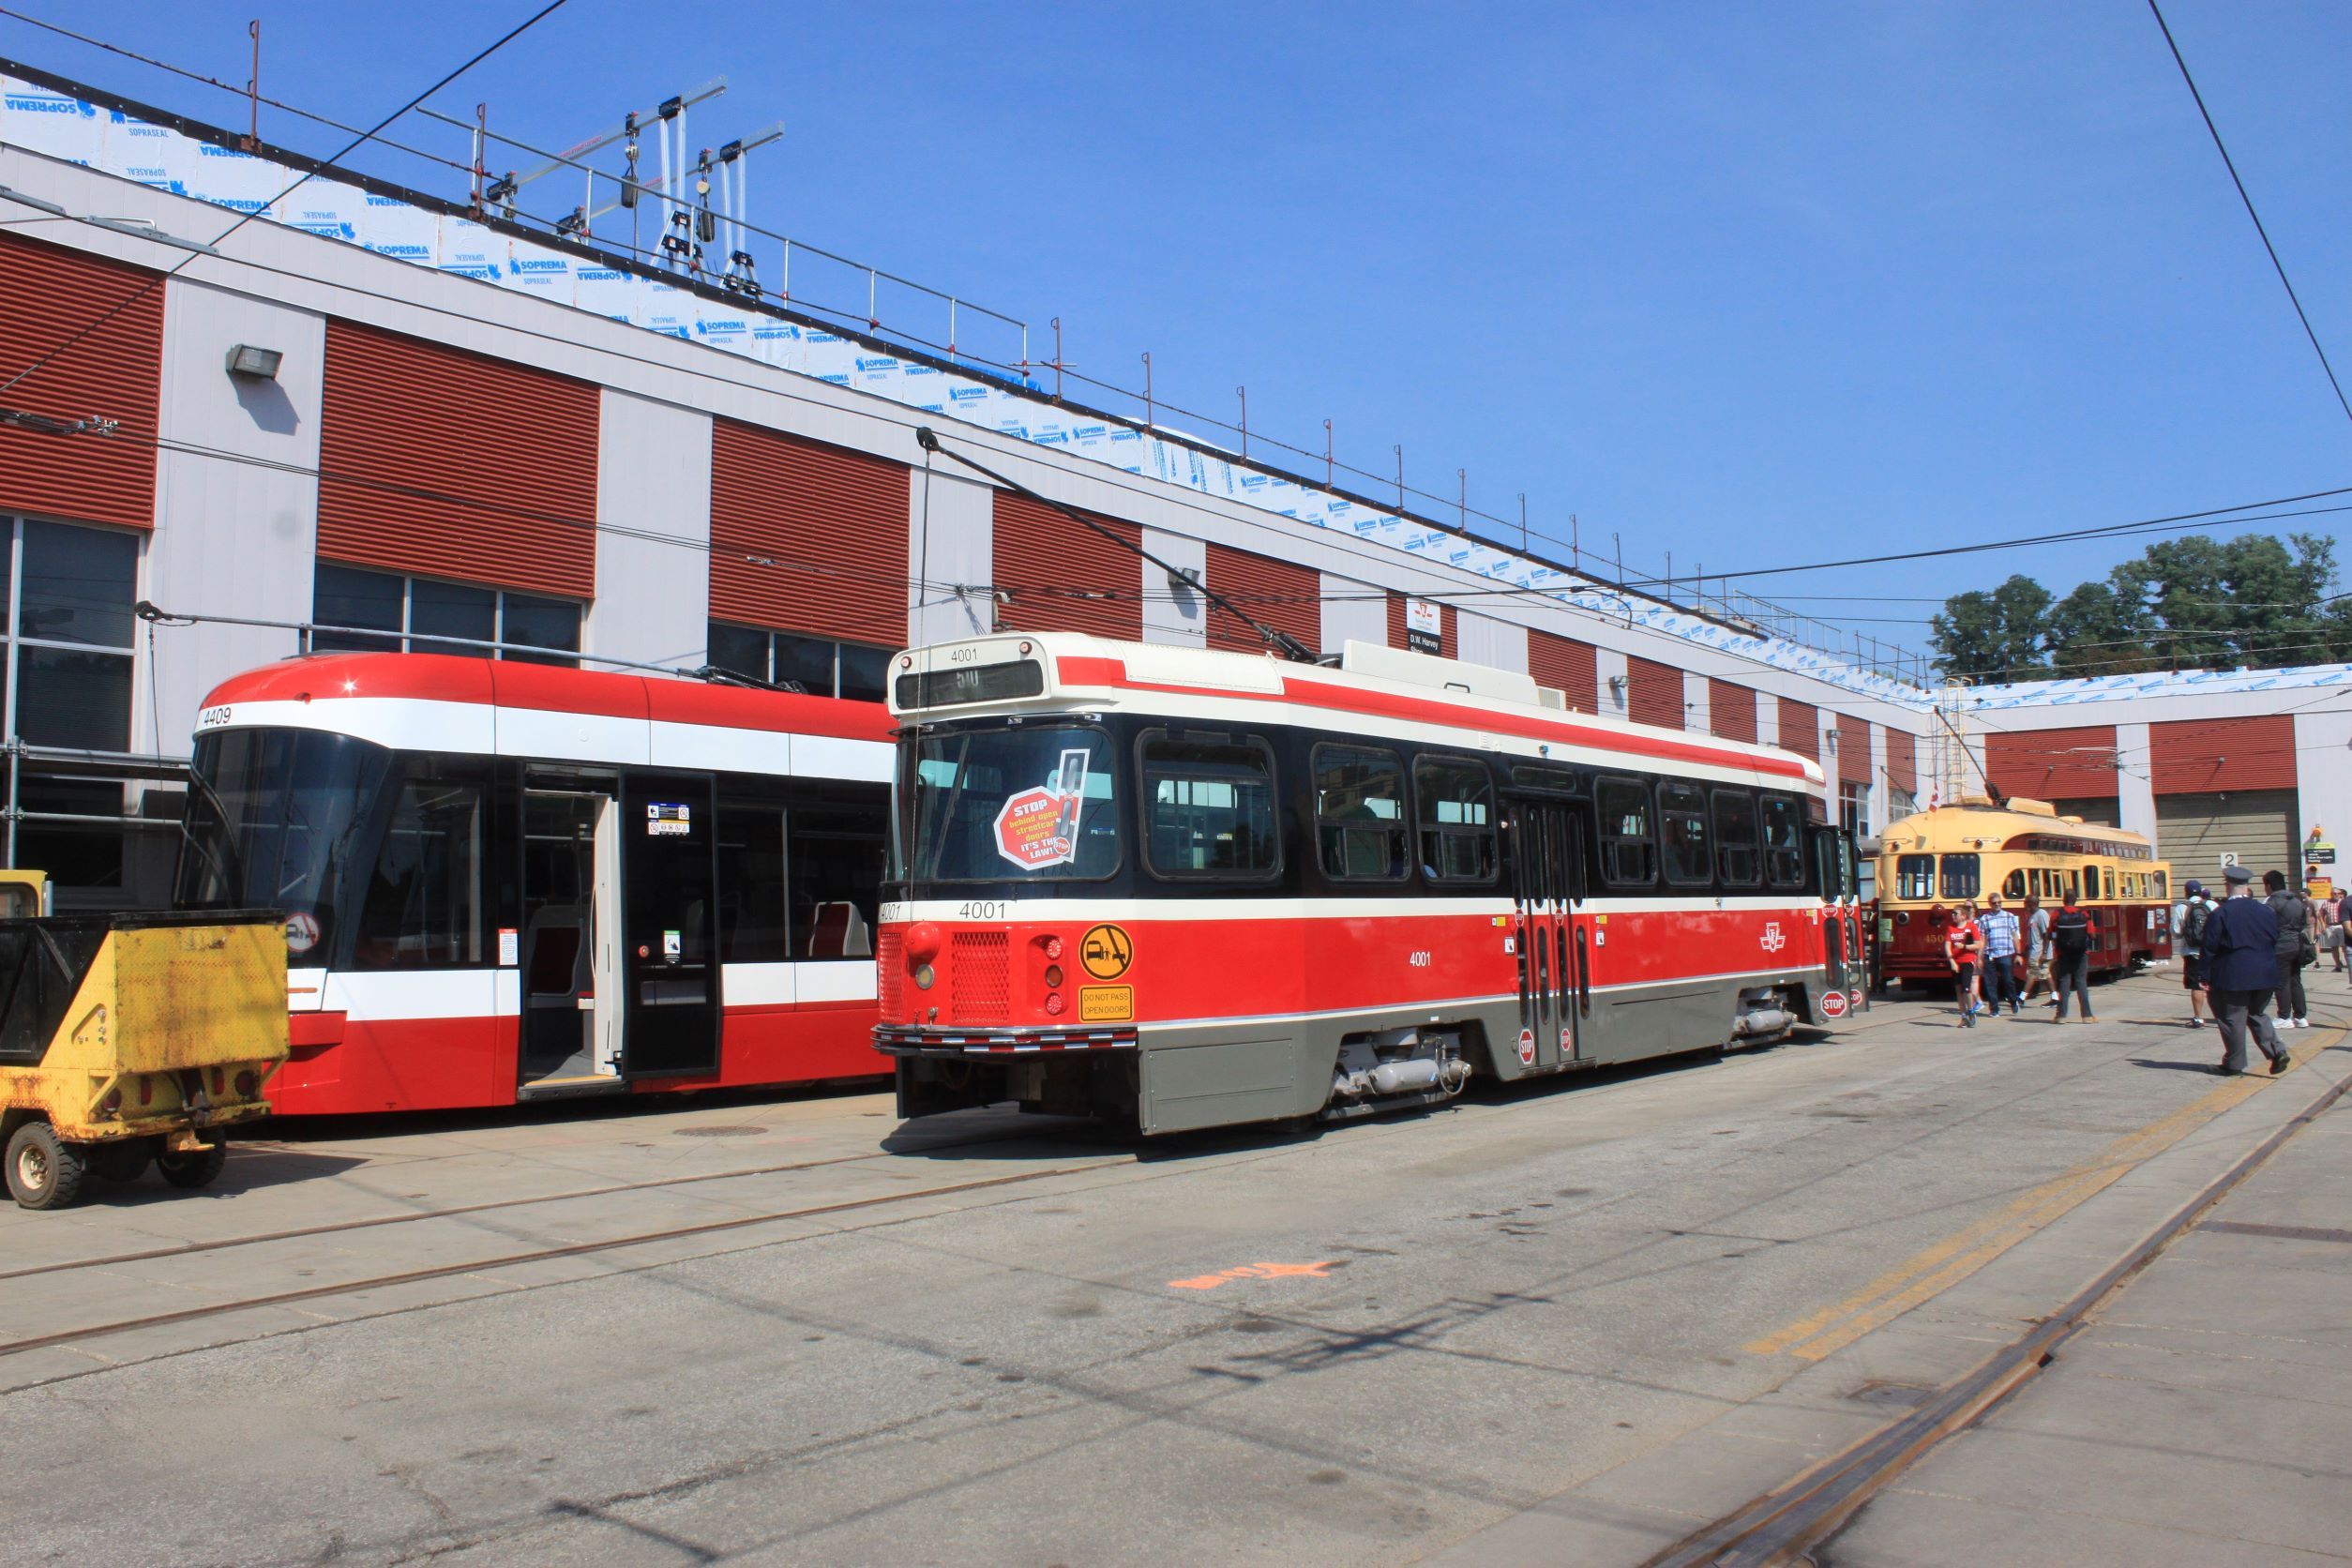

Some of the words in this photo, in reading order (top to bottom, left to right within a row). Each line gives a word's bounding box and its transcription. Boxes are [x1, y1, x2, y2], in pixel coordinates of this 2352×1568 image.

[5, 98, 78, 114] SOPREMA
[128, 128, 170, 138] SOPRASEAL
[127, 167, 167, 177] SOPRASEAL
[377, 245, 430, 256] SOPREMA
[520, 260, 567, 270] SOPREMA
[577, 267, 622, 281] SOPREMA
[706, 321, 746, 330] SOPREMA
[754, 330, 792, 340] SOPREMA
[865, 357, 898, 368] SOPREMA
[957, 387, 988, 397] SOPREMA
[1423, 638, 1439, 651] Harvey
[951, 647, 977, 663] 4001
[204, 706, 232, 726] 4409
[1014, 798, 1048, 818] STOP
[1008, 815, 1036, 829] behind
[1038, 810, 1059, 822] open
[1016, 820, 1056, 837] streetcar
[1025, 831, 1051, 842] doors
[1020, 840, 1039, 852] IT'S
[1030, 847, 1055, 859] LAW!
[2224, 853, 2236, 867] 2
[959, 901, 1005, 919] 4001
[1410, 951, 1430, 967] 4001
[1083, 994, 1094, 1003] DO
[1094, 993, 1110, 1002] NOT
[1110, 992, 1129, 1002] PASS
[1084, 1006, 1104, 1015] OPEN
[1823, 999, 1844, 1010] STOP
[1521, 1039, 1532, 1054] STOP
